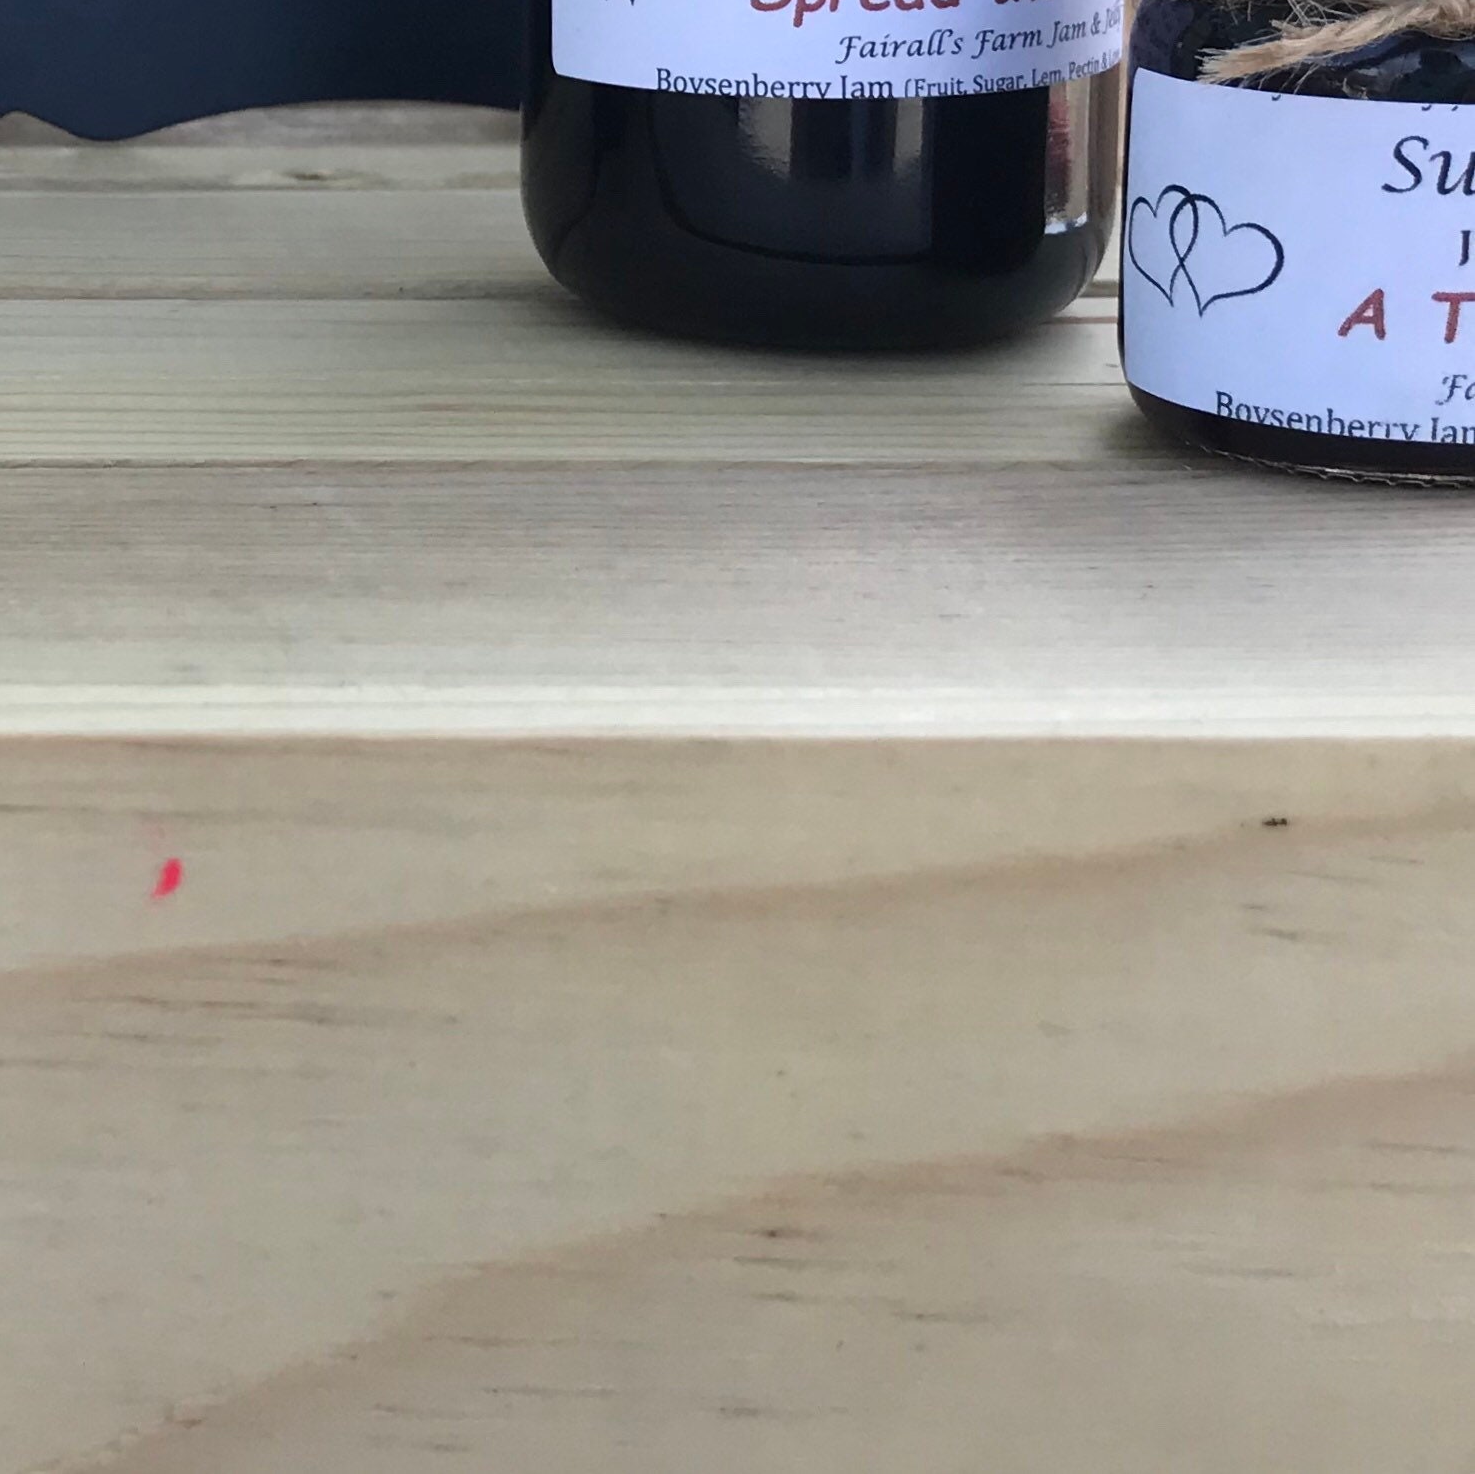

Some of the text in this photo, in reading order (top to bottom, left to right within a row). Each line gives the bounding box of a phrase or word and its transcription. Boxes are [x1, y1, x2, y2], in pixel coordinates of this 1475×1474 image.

[835, 31, 964, 64] Fairall's
[970, 29, 1044, 60] Farm
[1045, 20, 1086, 50] Jam
[1090, 12, 1101, 36] &
[1381, 134, 1475, 196] Su
[1337, 287, 1387, 341] A
[1430, 416, 1475, 444] Ja
